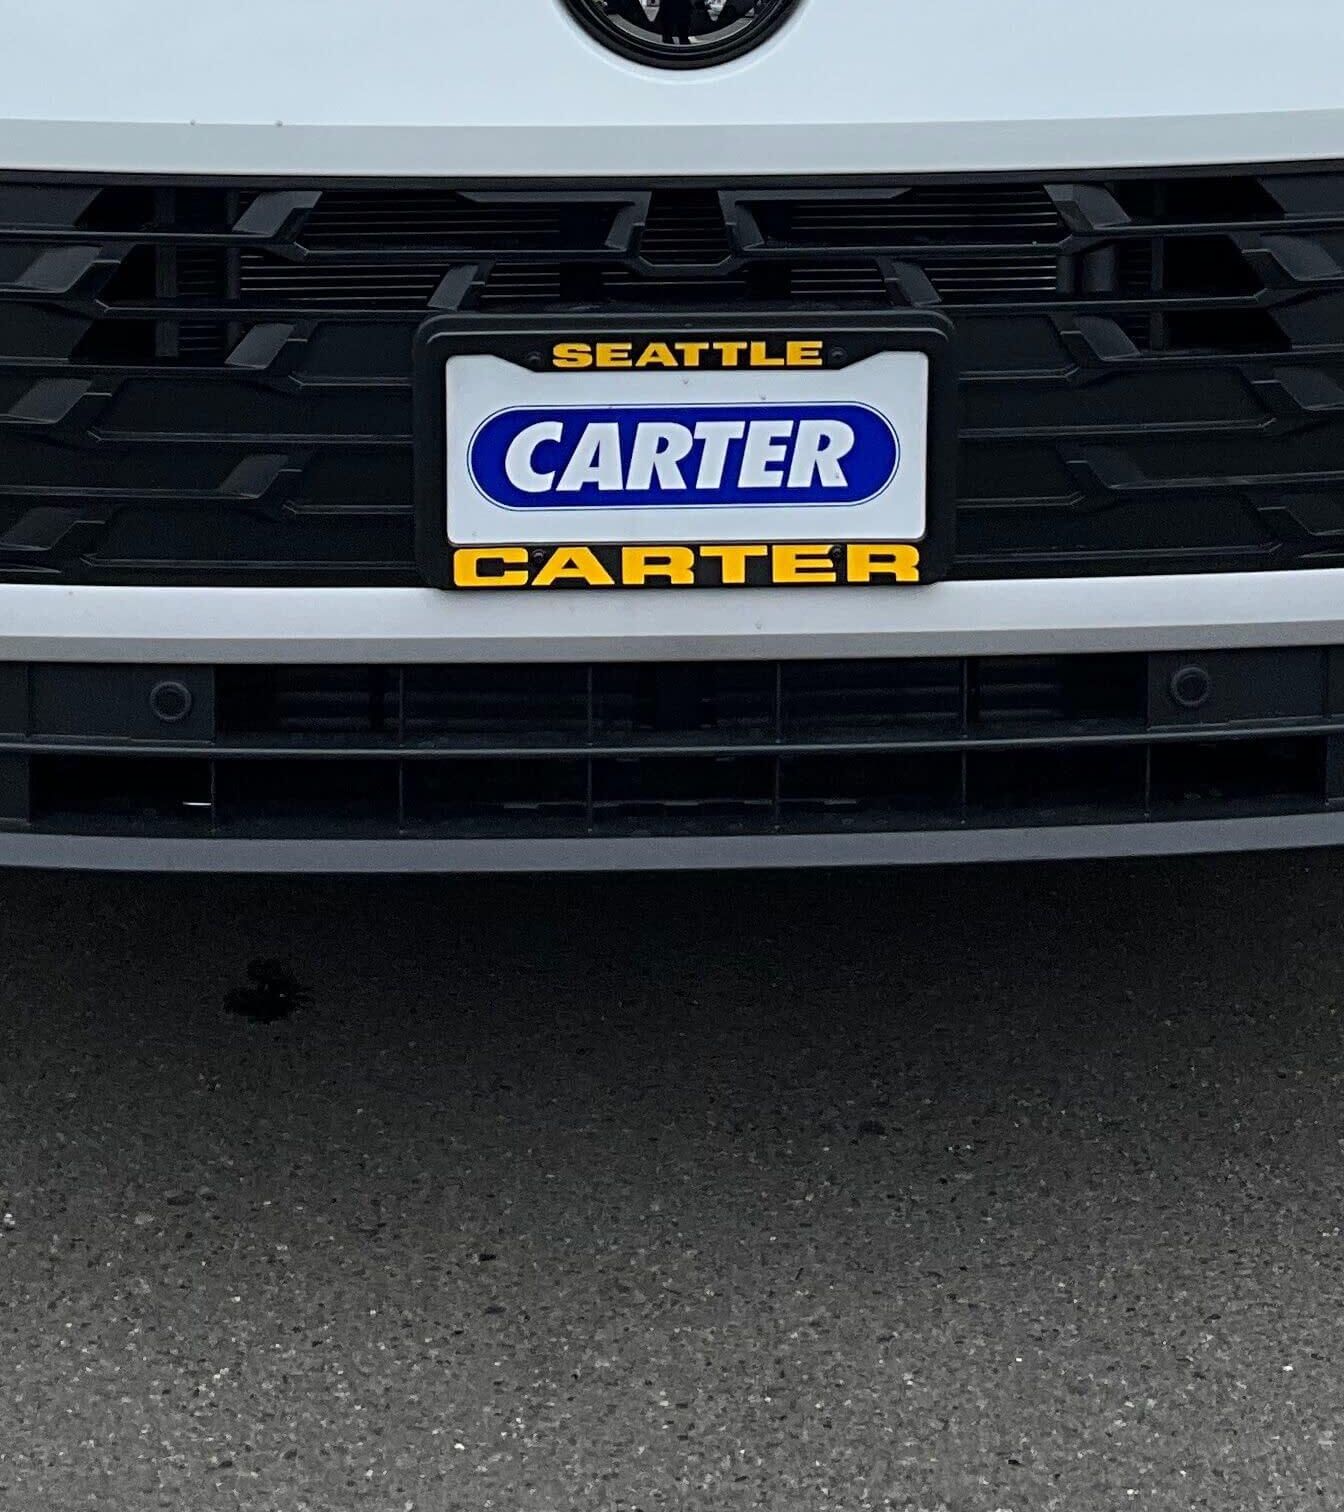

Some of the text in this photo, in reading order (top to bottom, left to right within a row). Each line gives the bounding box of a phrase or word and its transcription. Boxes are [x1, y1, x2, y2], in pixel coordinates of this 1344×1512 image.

[552, 340, 824, 368] SEATTLE
[504, 419, 855, 493] CARTER
[453, 543, 920, 587] CARTER
